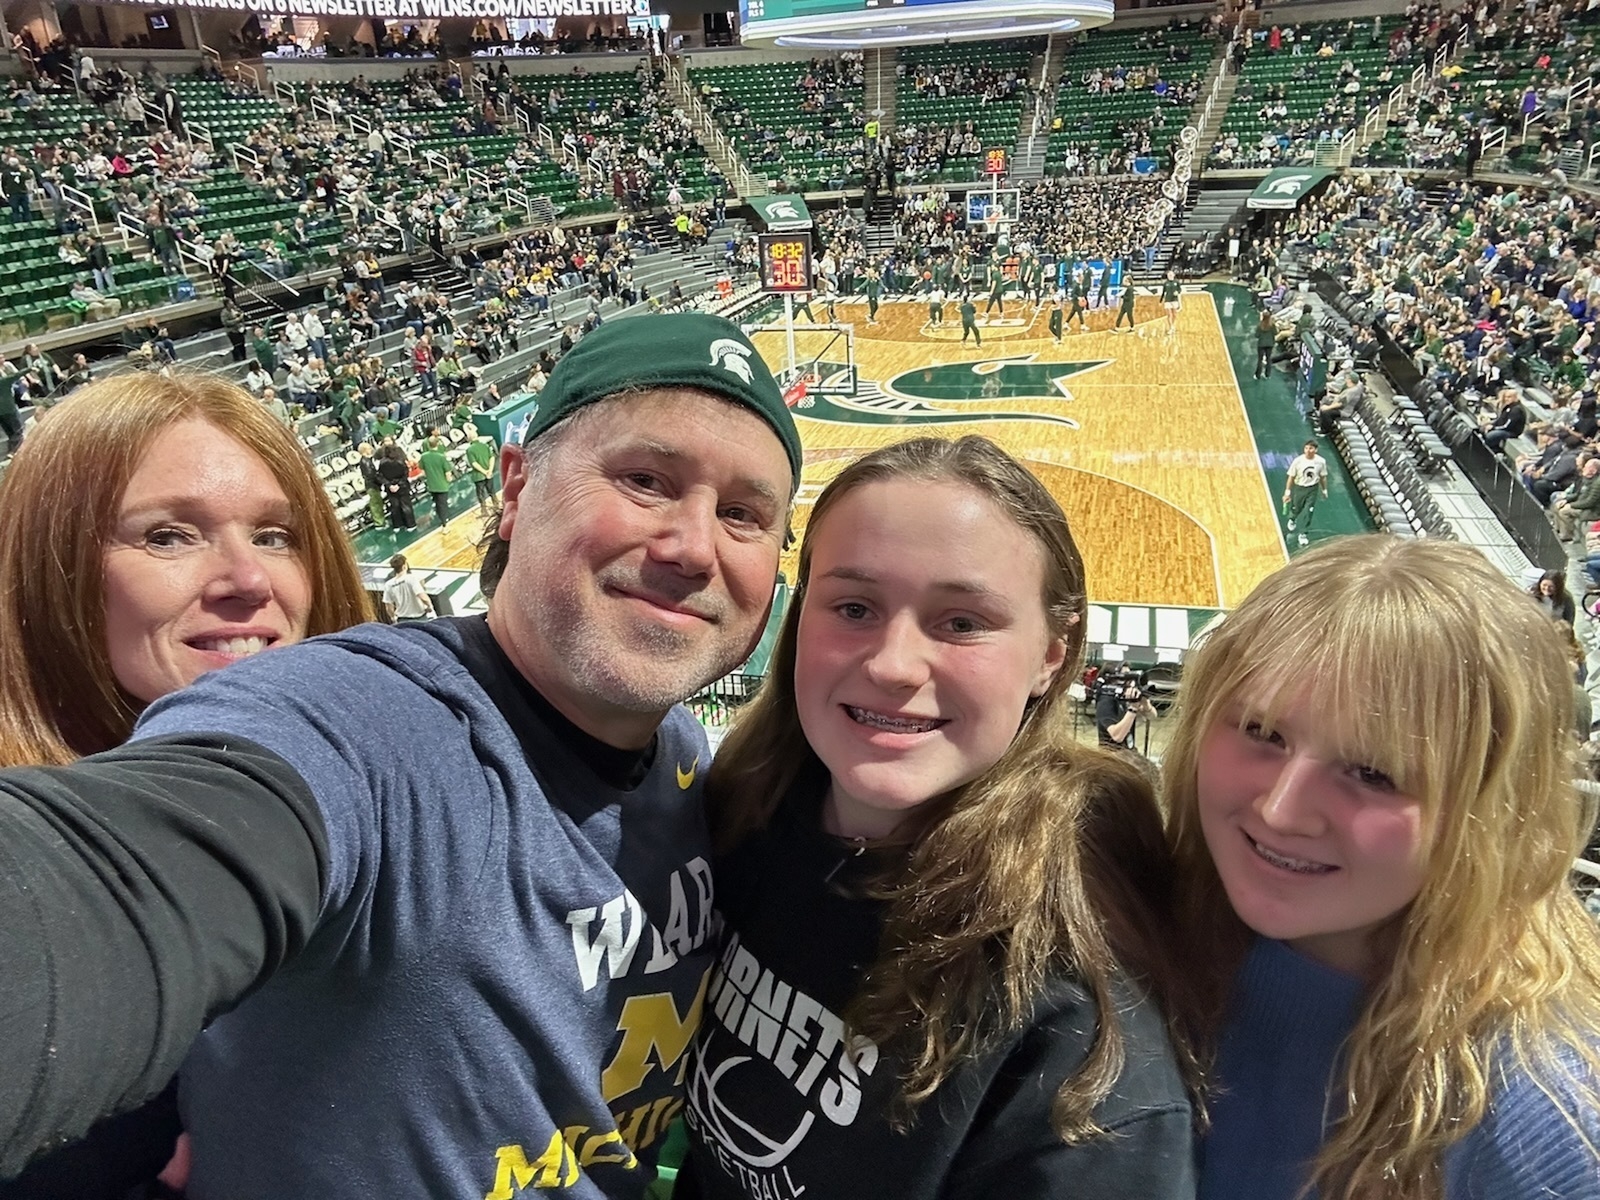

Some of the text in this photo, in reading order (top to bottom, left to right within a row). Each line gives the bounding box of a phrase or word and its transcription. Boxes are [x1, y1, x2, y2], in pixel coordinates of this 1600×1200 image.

[246, 0, 274, 11] ON
[289, 0, 398, 16] NEWSLETTER
[399, 0, 419, 16] AT
[420, 0, 633, 17] WLNS.COM/NEWSLETTER
[770, 242, 803, 259] 18:32
[772, 260, 801, 287] 30
